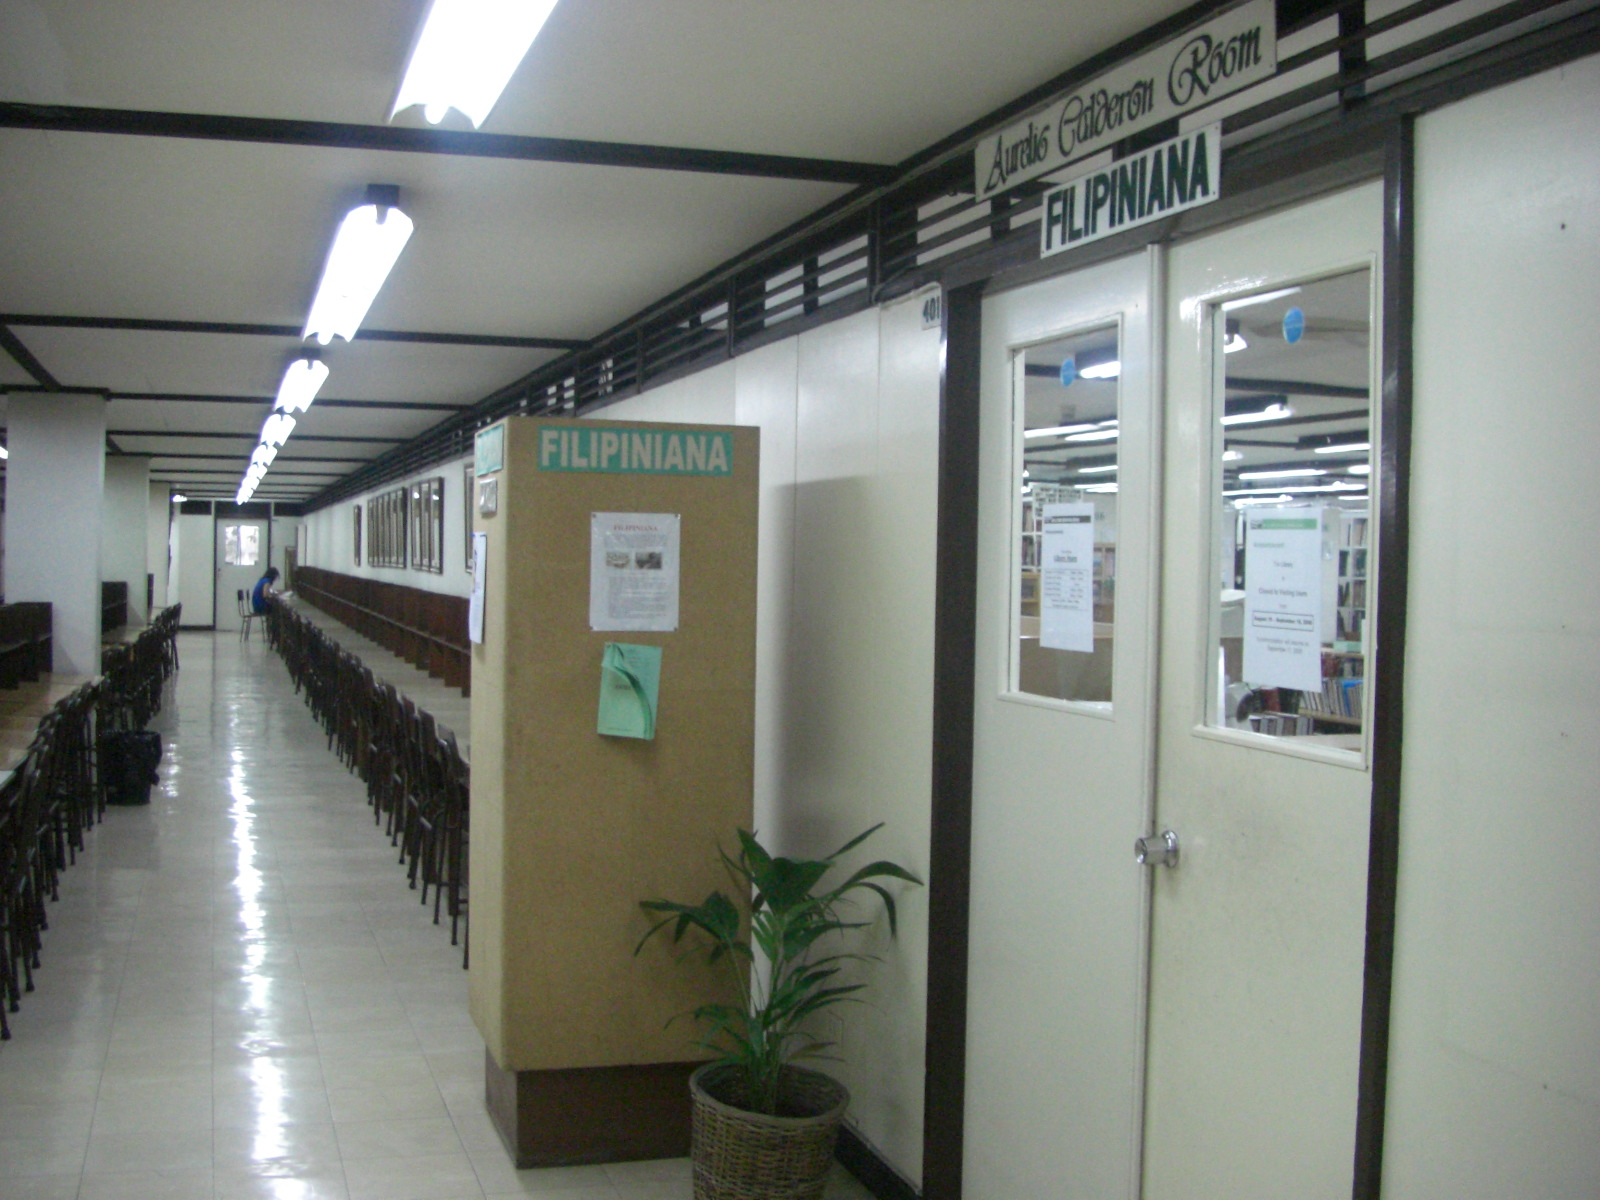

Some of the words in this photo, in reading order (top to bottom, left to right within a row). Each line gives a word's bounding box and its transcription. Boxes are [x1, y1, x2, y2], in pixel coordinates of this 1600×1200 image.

[984, 122, 1050, 193] Aurelio
[1058, 77, 1155, 158] Calderon
[1167, 25, 1263, 107] Room
[1046, 132, 1210, 251] FILIPINIANA
[541, 429, 729, 472] FILIPINIANA
